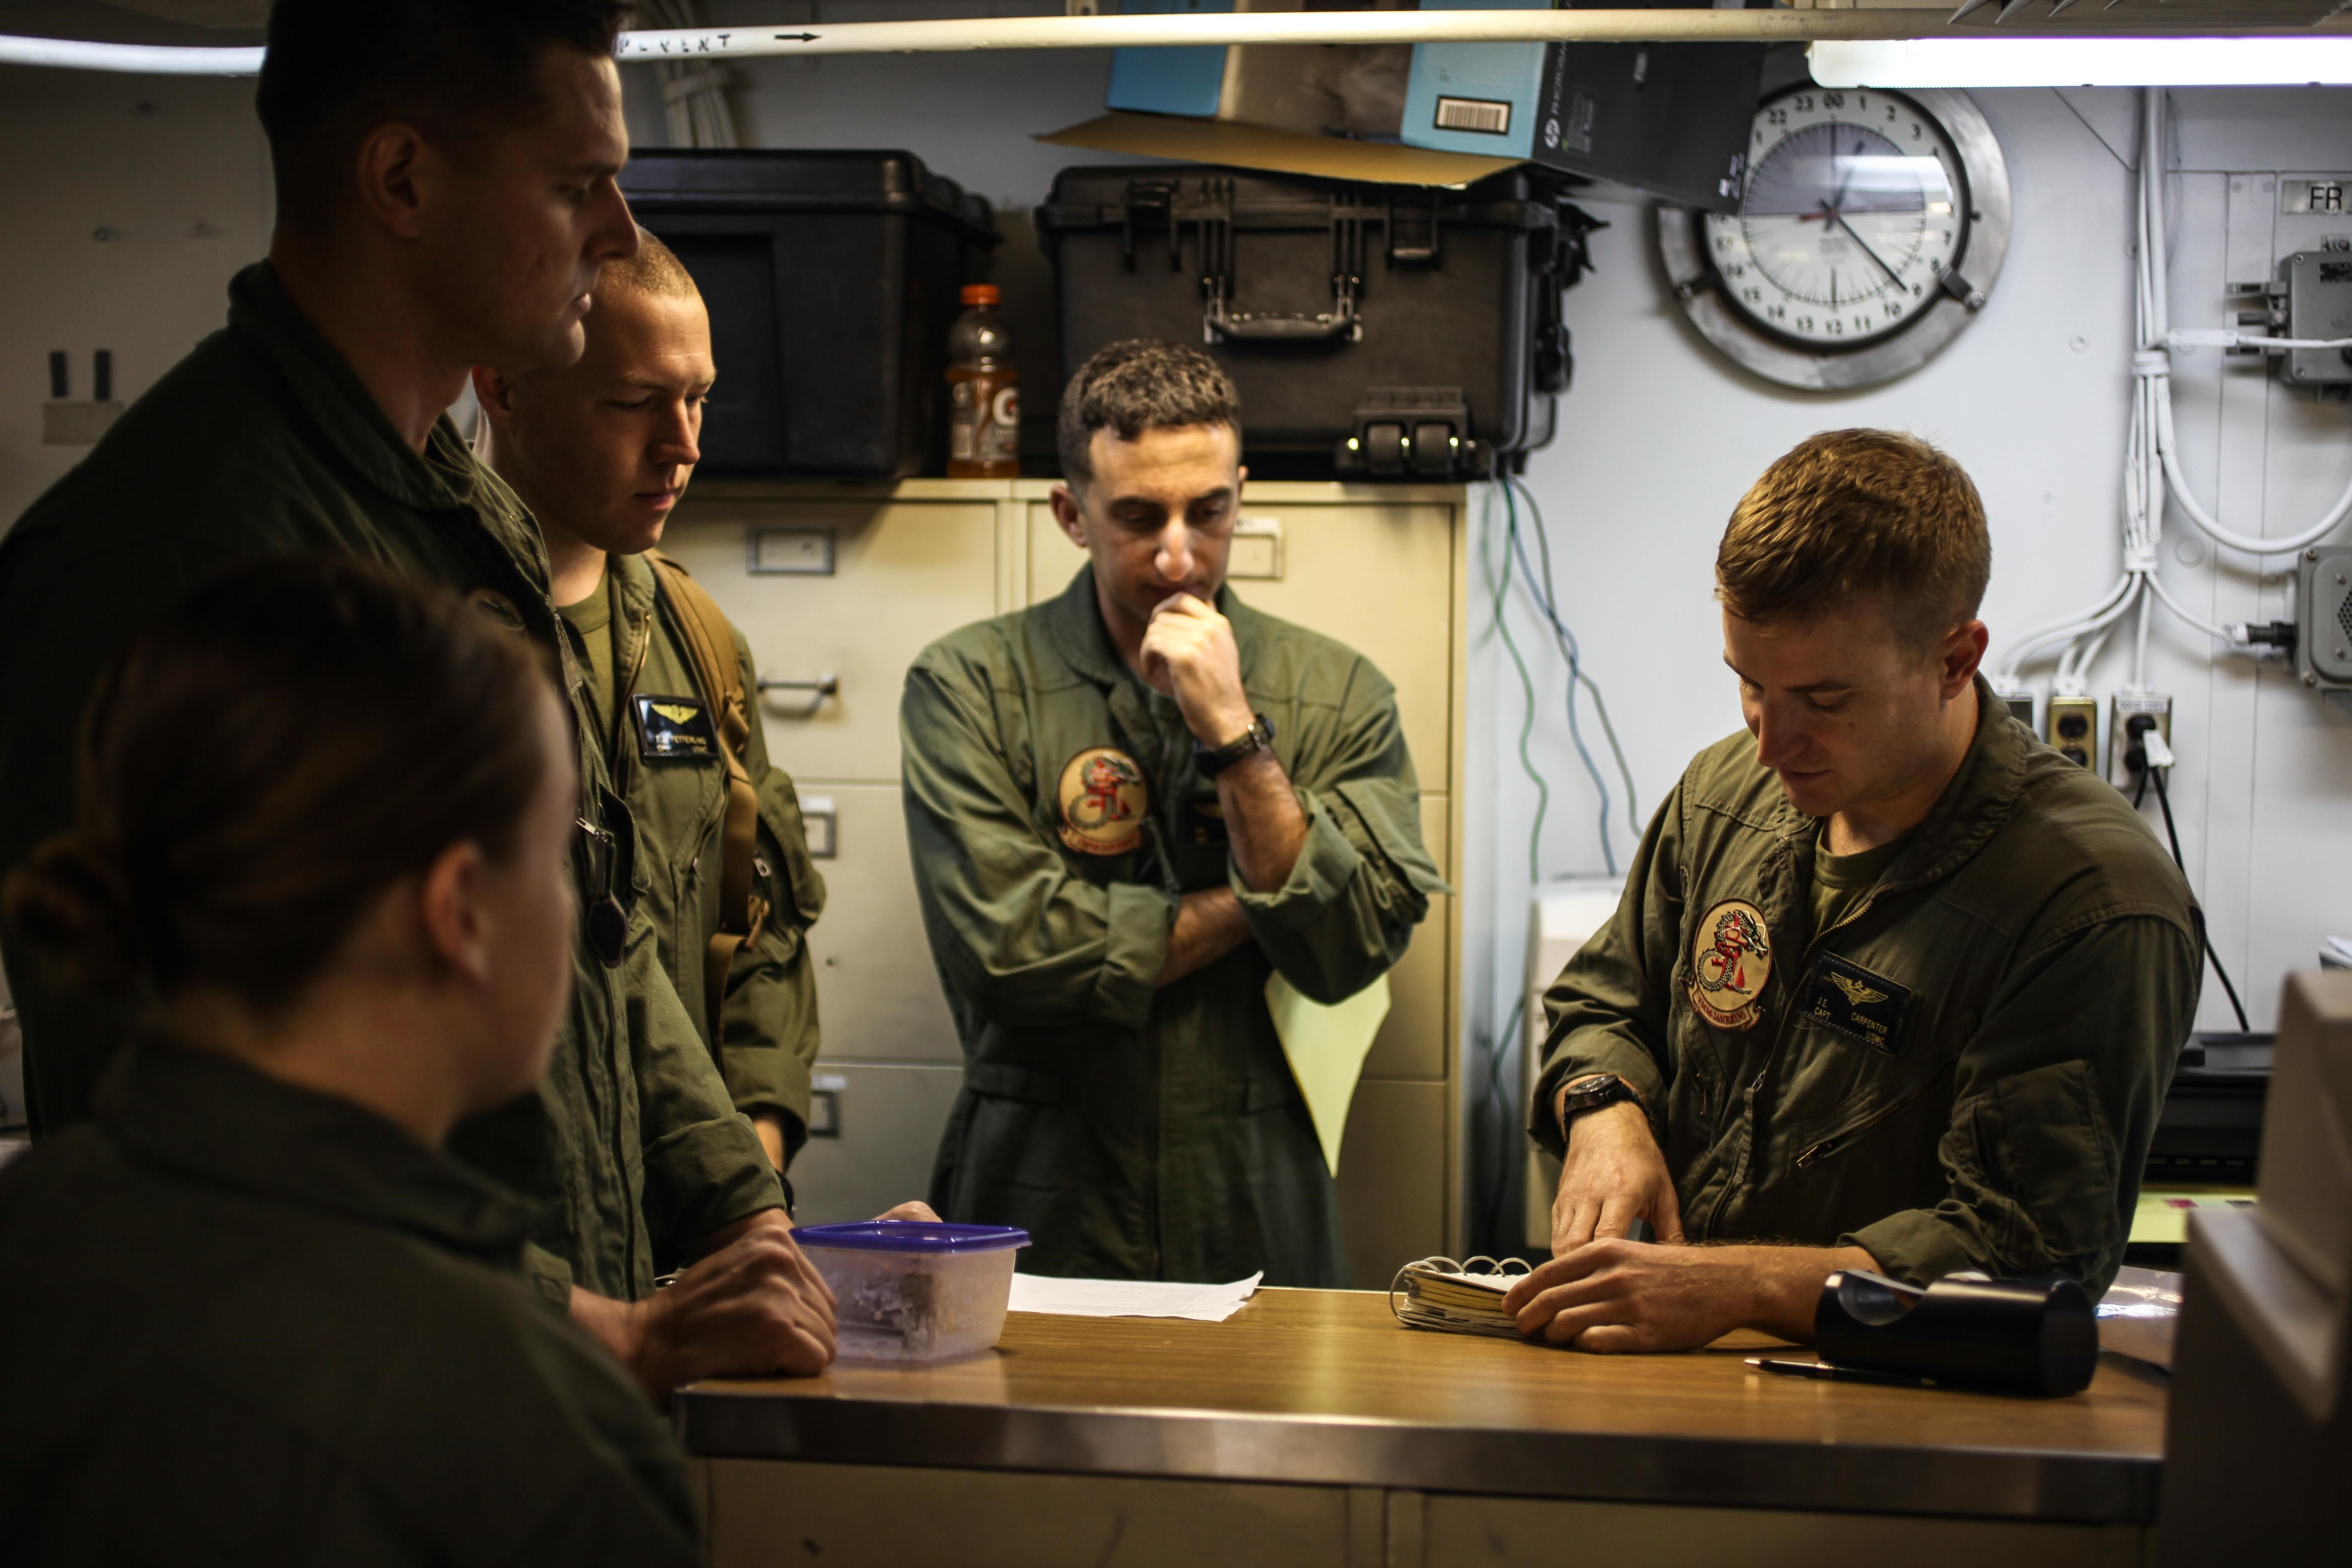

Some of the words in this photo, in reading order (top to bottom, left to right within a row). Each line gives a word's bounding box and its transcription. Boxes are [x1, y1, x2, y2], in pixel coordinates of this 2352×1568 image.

[1886, 105, 1896, 121] 2
[1911, 123, 1921, 140] 3
[1814, 1007, 1831, 1020] CAPT
[1866, 1031, 1885, 1045] USMC
[1851, 1012, 1888, 1035] CARPENTER
